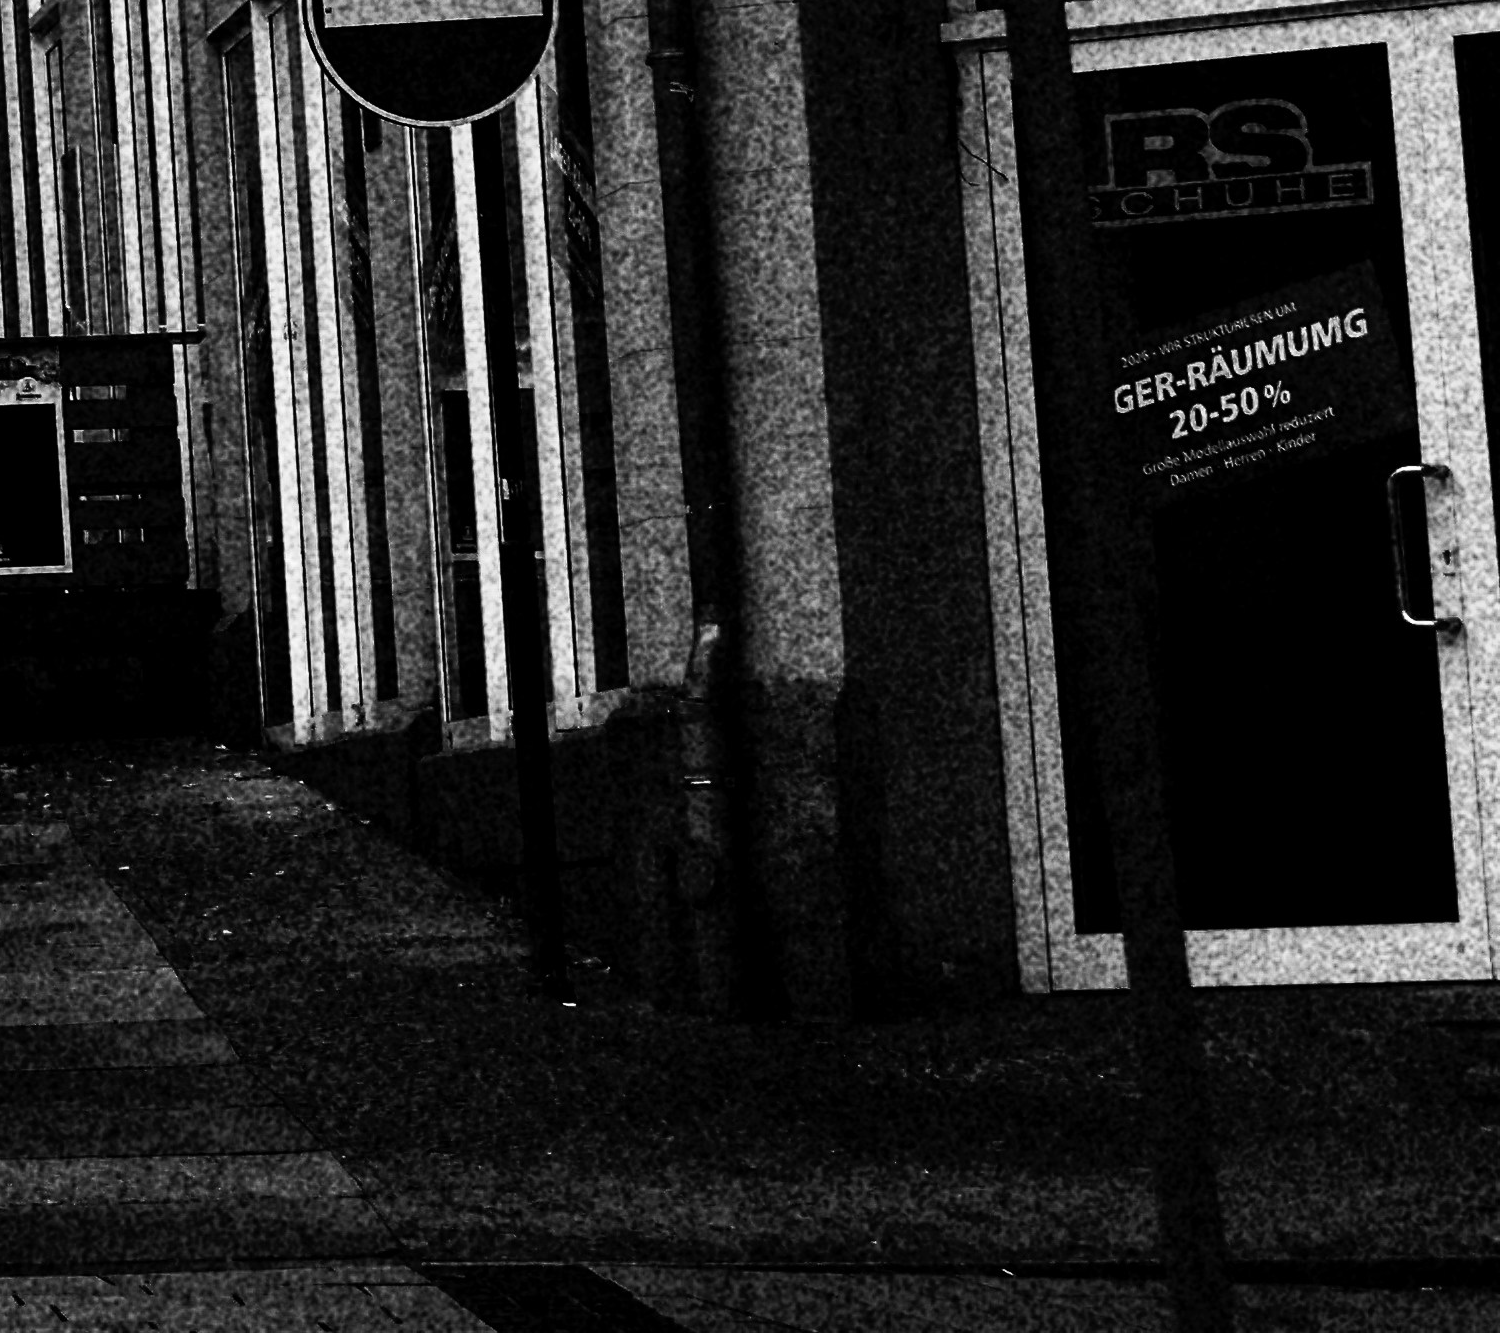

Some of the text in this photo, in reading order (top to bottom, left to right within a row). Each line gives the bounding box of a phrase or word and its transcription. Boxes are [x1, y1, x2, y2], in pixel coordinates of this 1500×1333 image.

[1103, 97, 1314, 188] RS
[1170, 462, 1213, 486] Damen
[1276, 429, 1317, 453] Kinder
